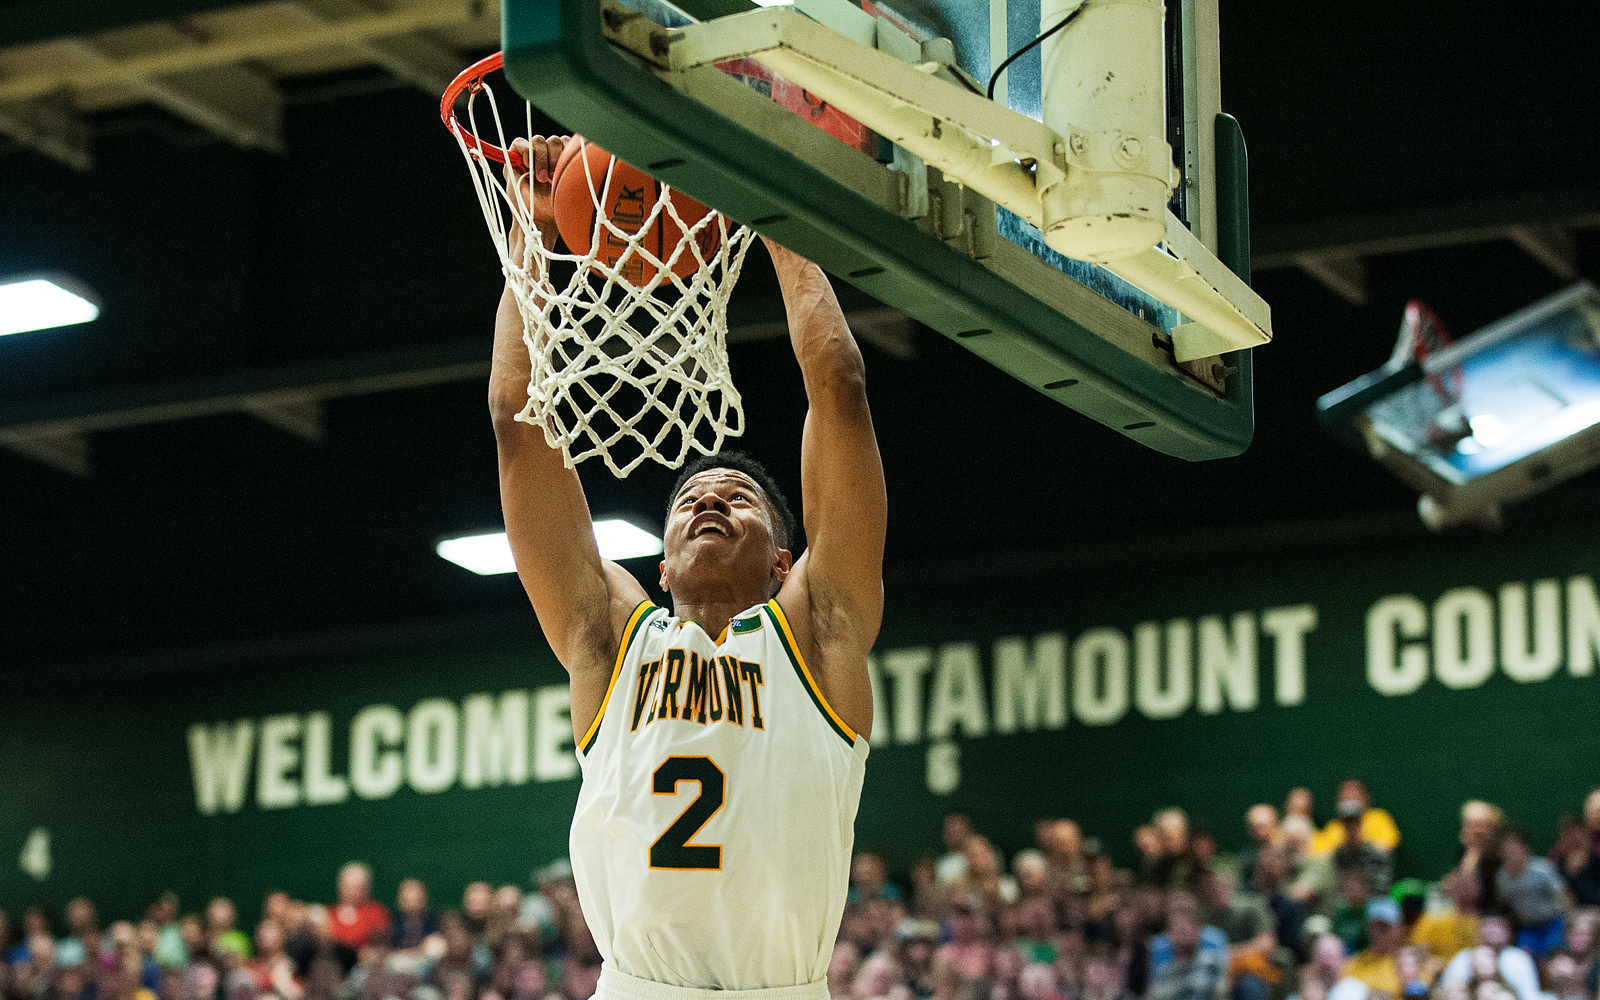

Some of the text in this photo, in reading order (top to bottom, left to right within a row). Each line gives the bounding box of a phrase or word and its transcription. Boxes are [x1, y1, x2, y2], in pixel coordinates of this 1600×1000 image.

[188, 684, 578, 815] WELCOME
[20, 827, 52, 881] 4
[648, 755, 726, 870] 2
